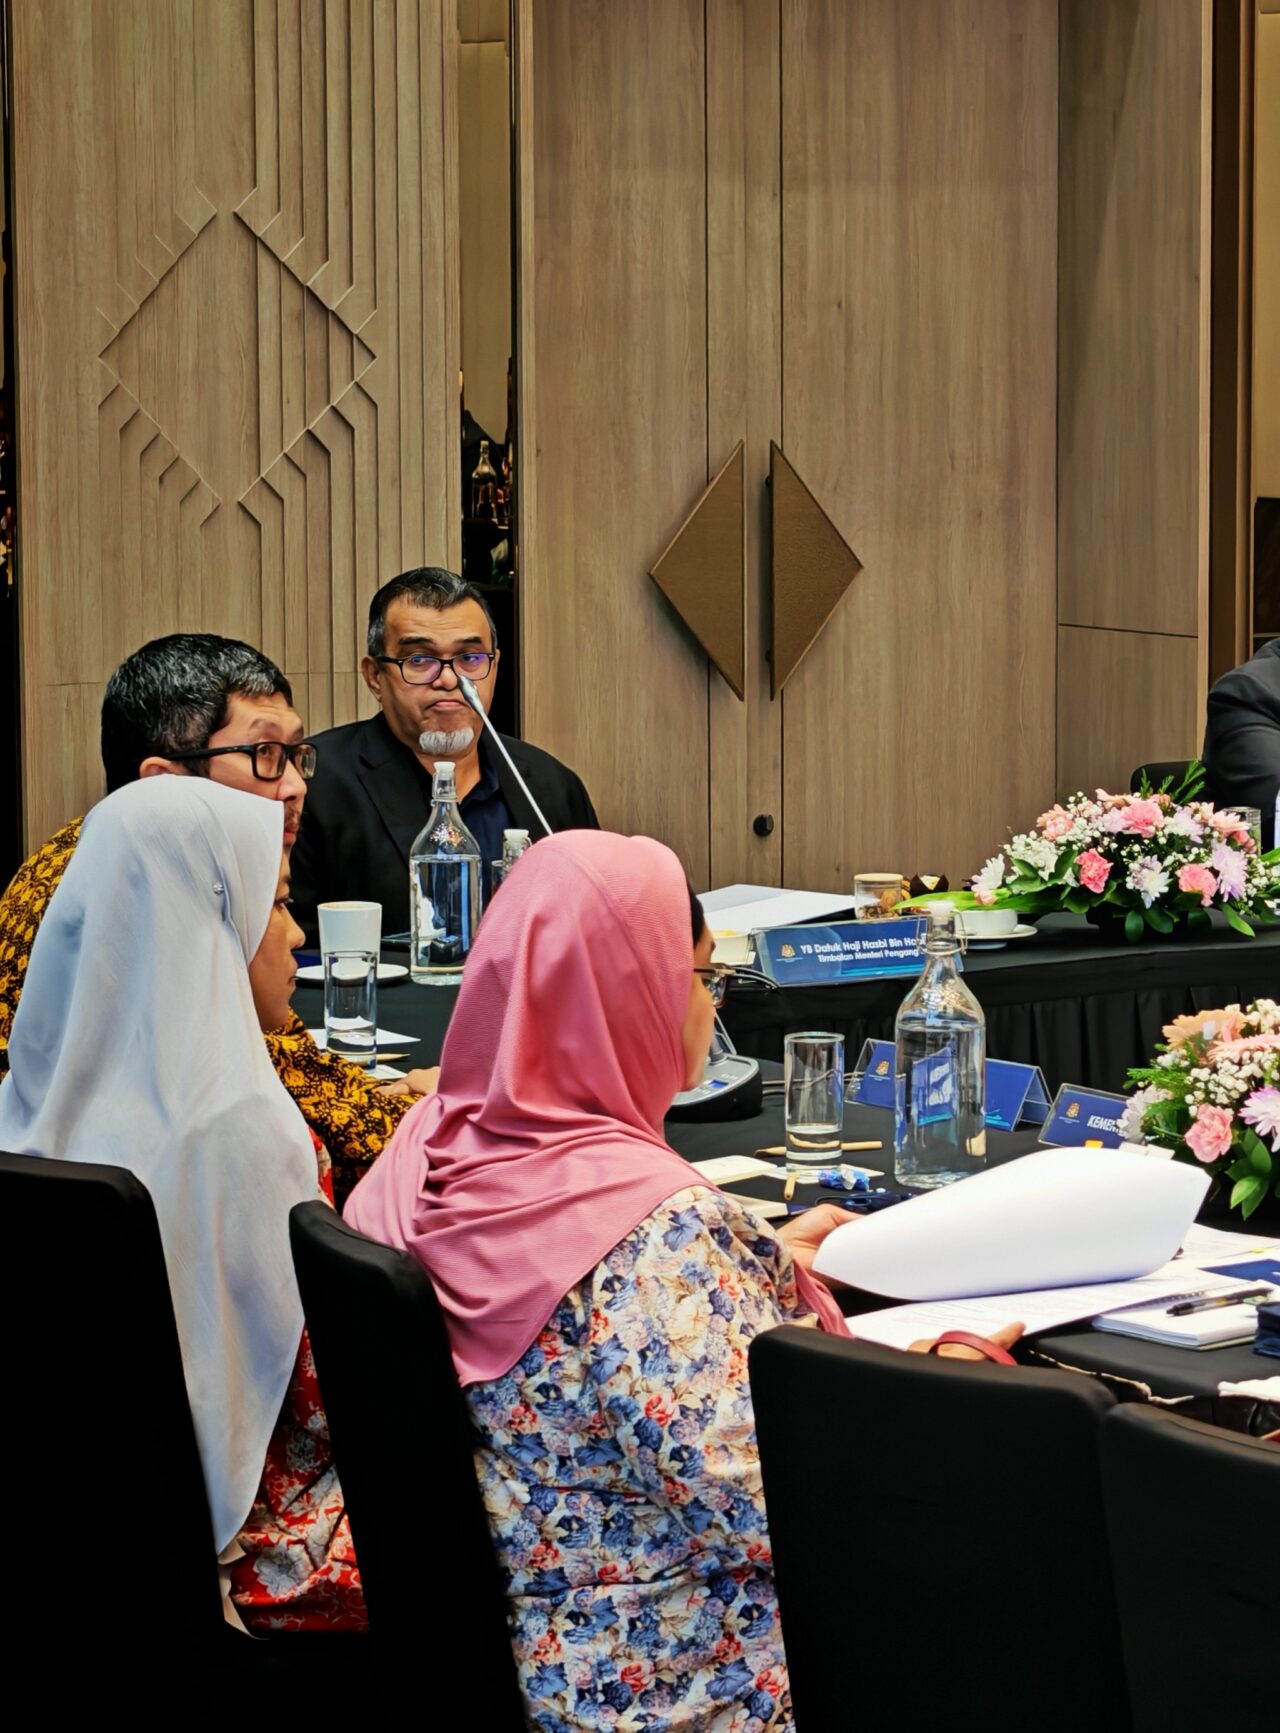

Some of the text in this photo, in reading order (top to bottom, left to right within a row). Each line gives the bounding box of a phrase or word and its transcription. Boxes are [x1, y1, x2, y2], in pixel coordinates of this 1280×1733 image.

[800, 944, 813, 954] YB
[814, 942, 842, 953] Datuk
[842, 941, 861, 952] Haji
[861, 938, 887, 950] Hasbi
[889, 937, 903, 948] Bin
[817, 953, 854, 962] Timbalan
[855, 950, 884, 960] Menteri
